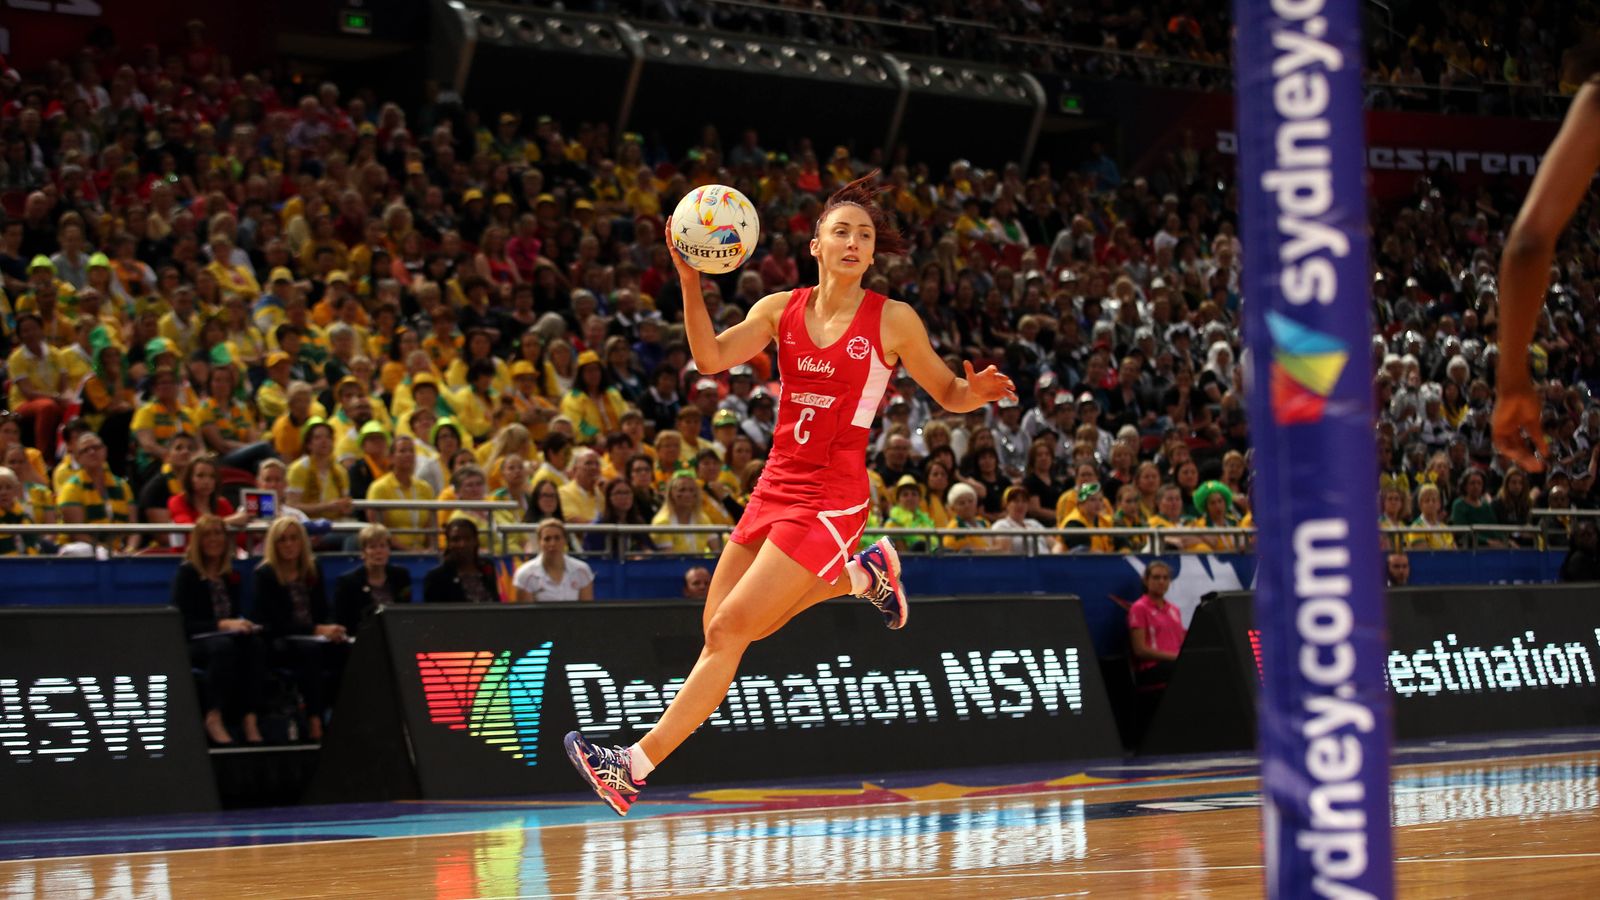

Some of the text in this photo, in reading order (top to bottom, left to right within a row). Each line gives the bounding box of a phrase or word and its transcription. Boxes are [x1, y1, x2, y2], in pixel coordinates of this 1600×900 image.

[797, 355, 836, 378] Vitality
[794, 407, 816, 445] C
[1384, 631, 1596, 697] estination
[565, 647, 1083, 734] Deination NSW
